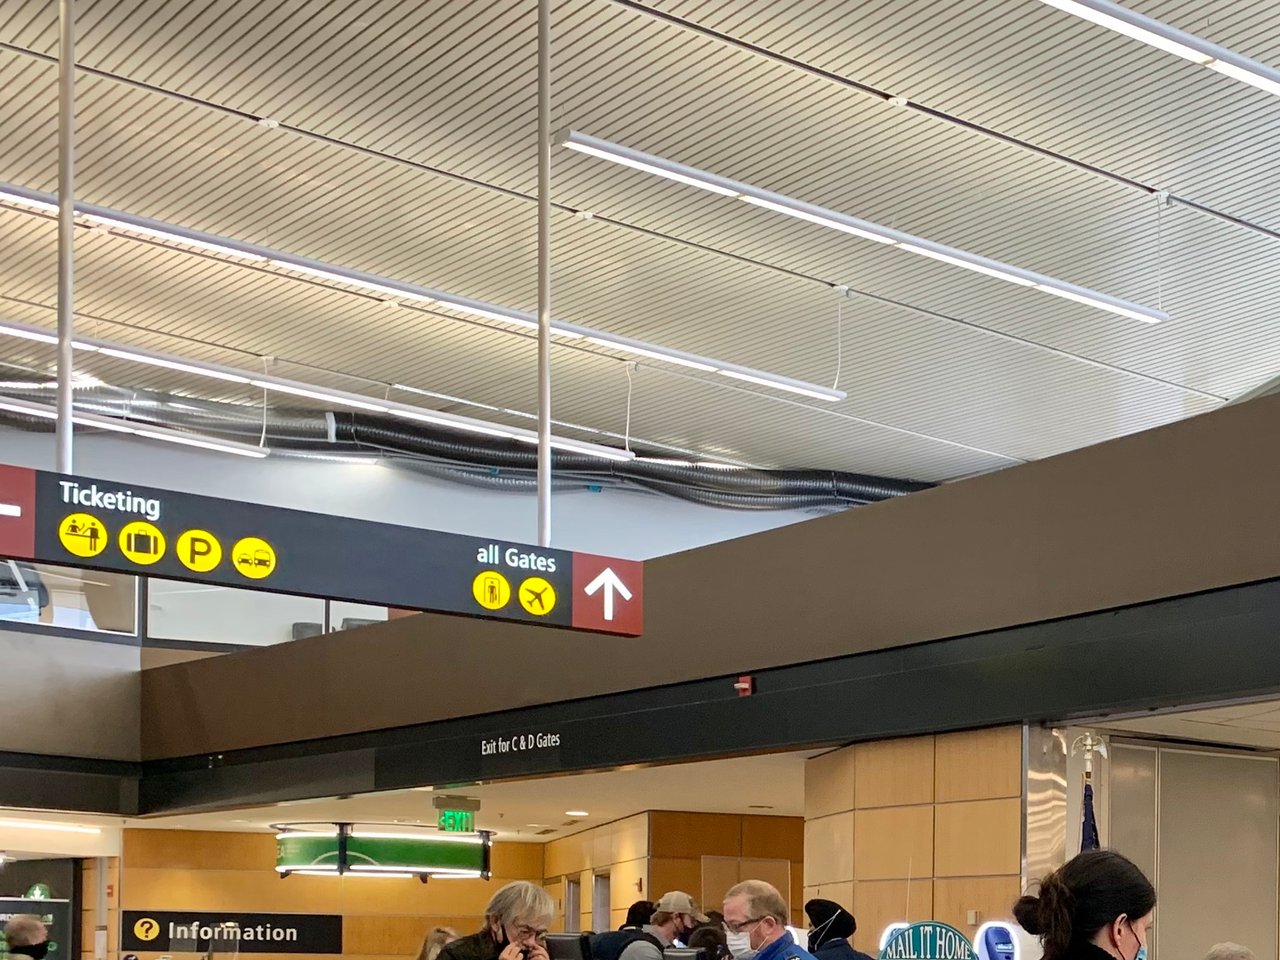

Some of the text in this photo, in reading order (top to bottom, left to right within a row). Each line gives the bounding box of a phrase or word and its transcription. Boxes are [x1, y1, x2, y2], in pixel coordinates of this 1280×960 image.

[59, 480, 160, 521] Ticketing
[477, 544, 556, 572] all Gates
[481, 732, 560, 755] Exit for C & D Gates
[445, 811, 473, 832] EXIT
[168, 921, 298, 941] Information
[886, 926, 972, 960] MAIL IT HOME
